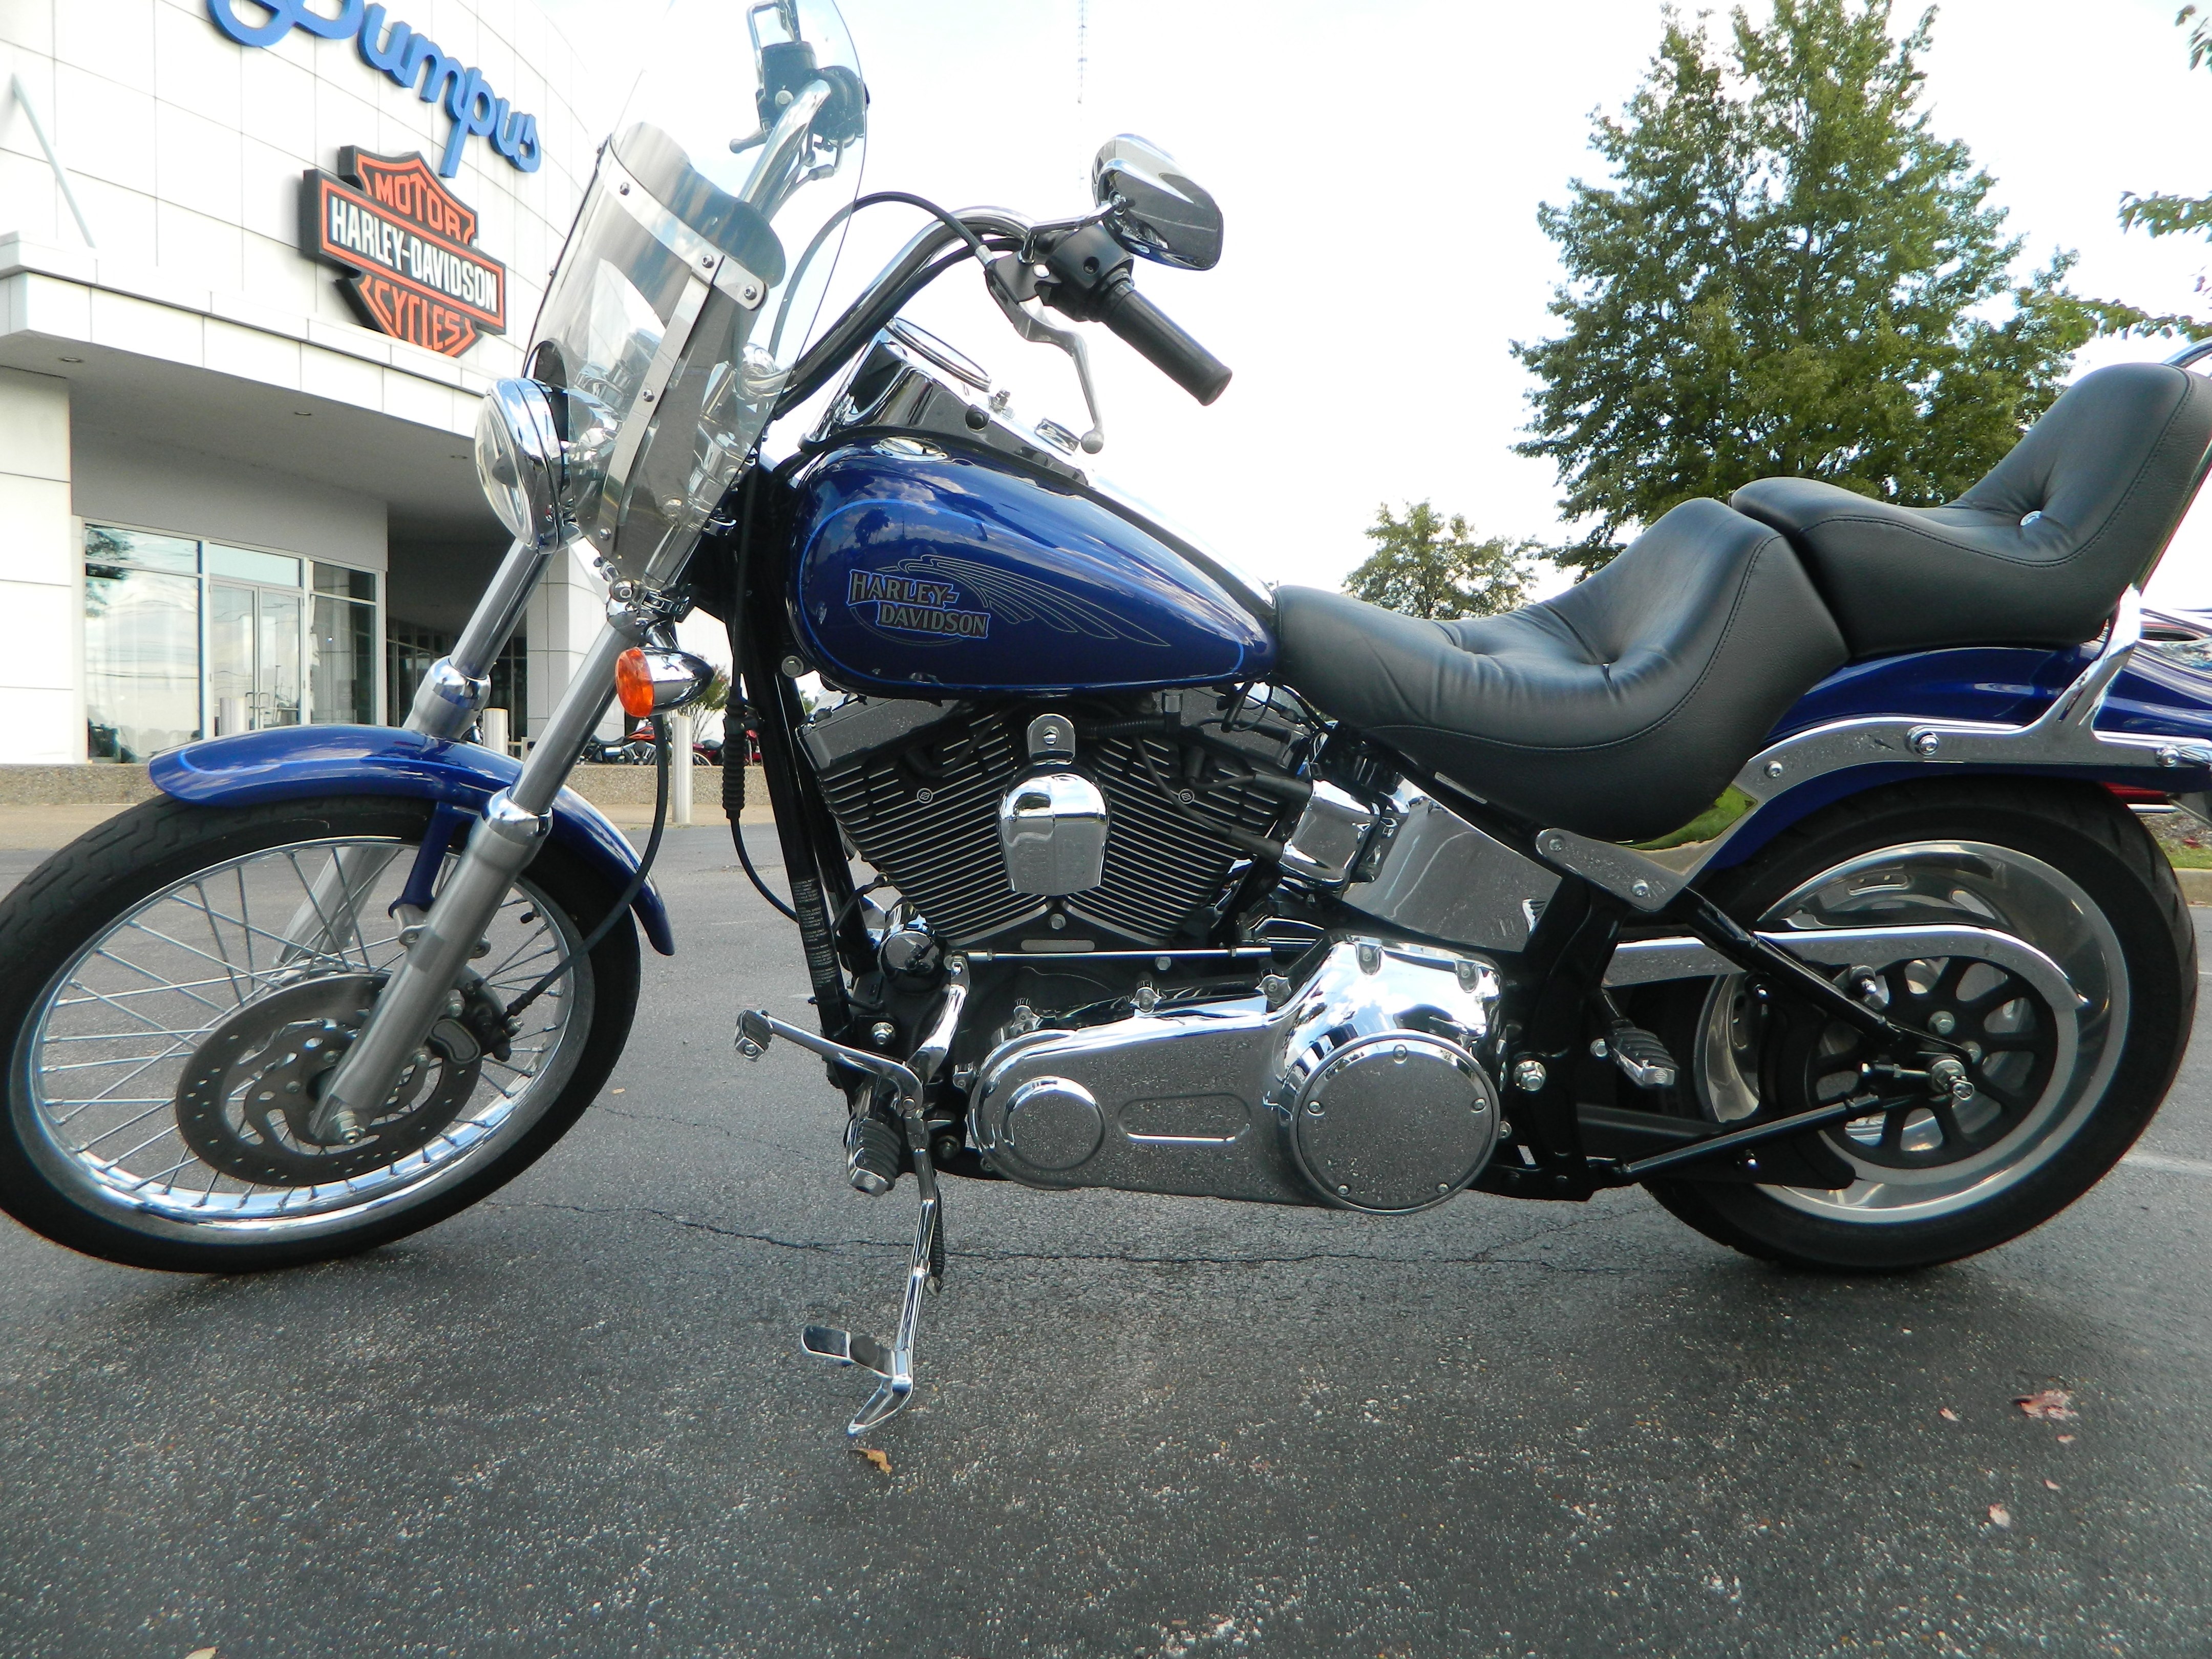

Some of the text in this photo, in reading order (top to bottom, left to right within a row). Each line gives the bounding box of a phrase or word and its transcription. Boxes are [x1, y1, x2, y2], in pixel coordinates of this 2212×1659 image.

[374, 172, 462, 243] MOTOR
[331, 196, 498, 313] HARLEY-DAVIDSON
[375, 282, 461, 350] CYCLES
[850, 571, 956, 605] HARLEY-
[880, 604, 988, 636] DAVIDSON
